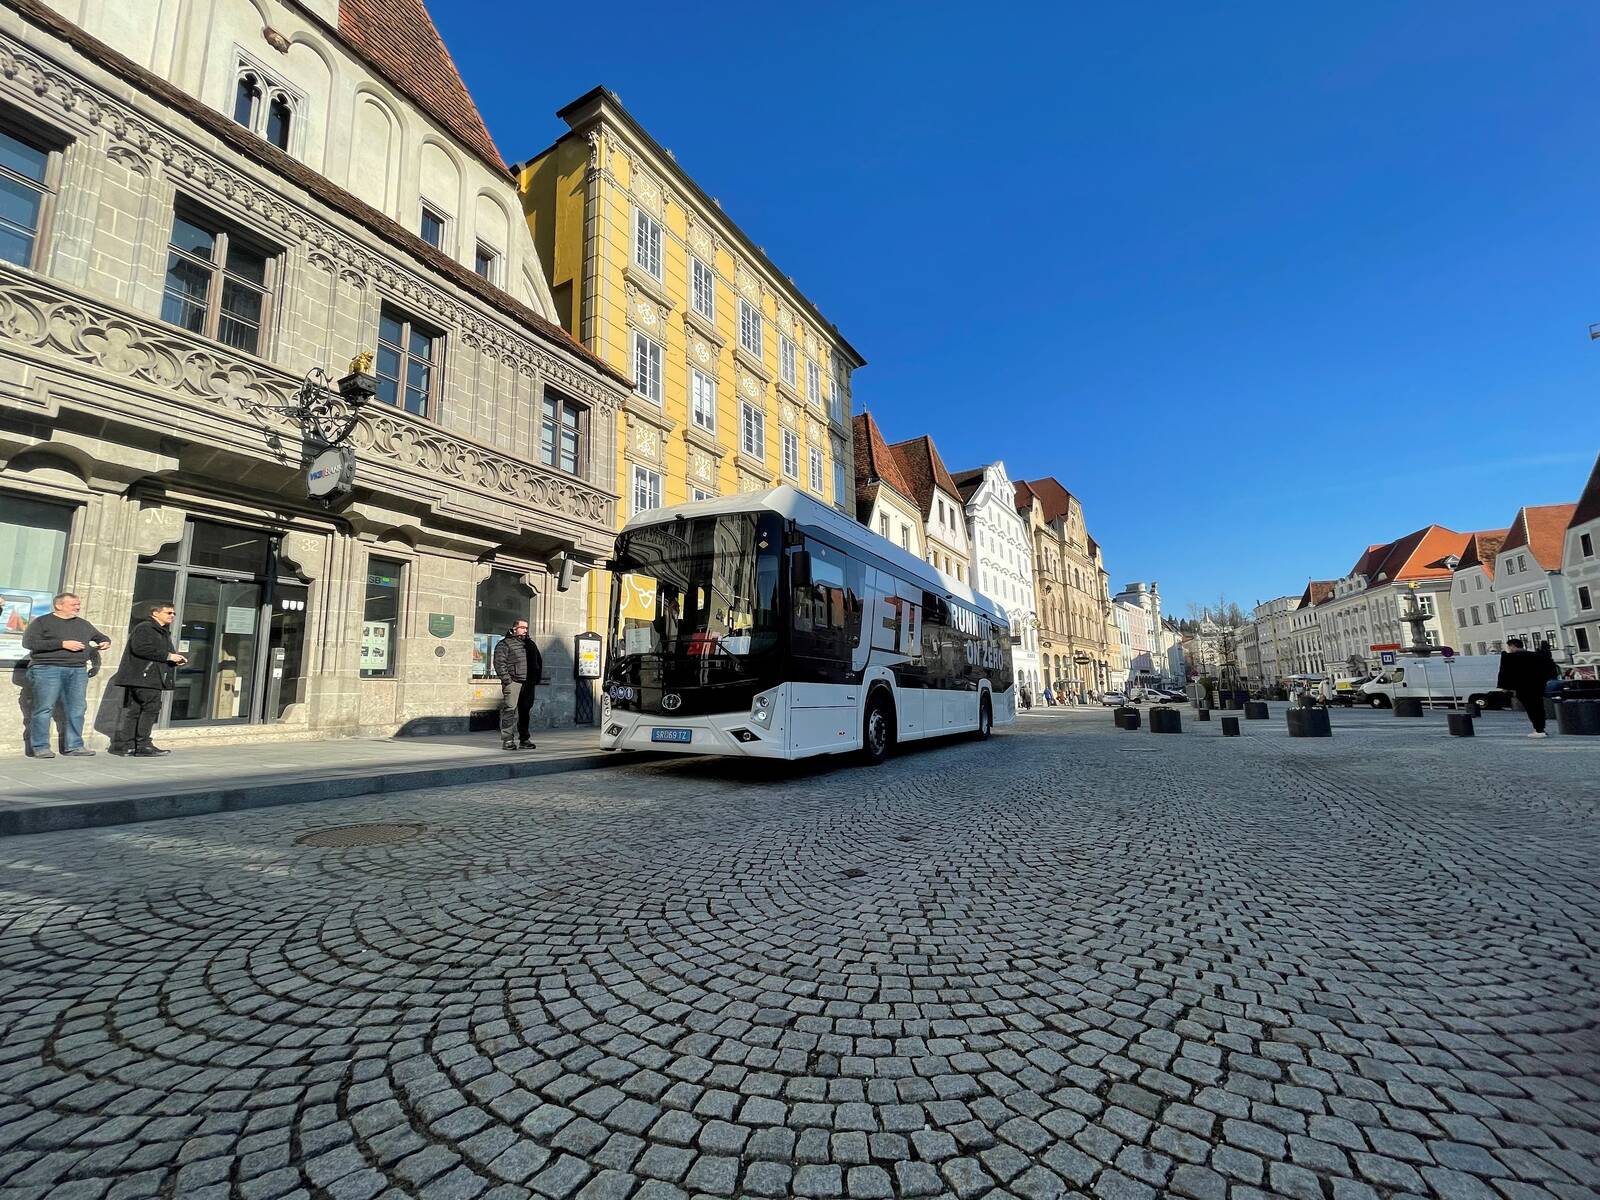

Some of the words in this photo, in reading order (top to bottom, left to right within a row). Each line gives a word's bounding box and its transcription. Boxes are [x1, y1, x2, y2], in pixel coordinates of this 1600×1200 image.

[302, 538, 319, 552] 32
[950, 603, 993, 641] RUNNING
[966, 639, 980, 666] ON
[982, 640, 1004, 670] ZERO
